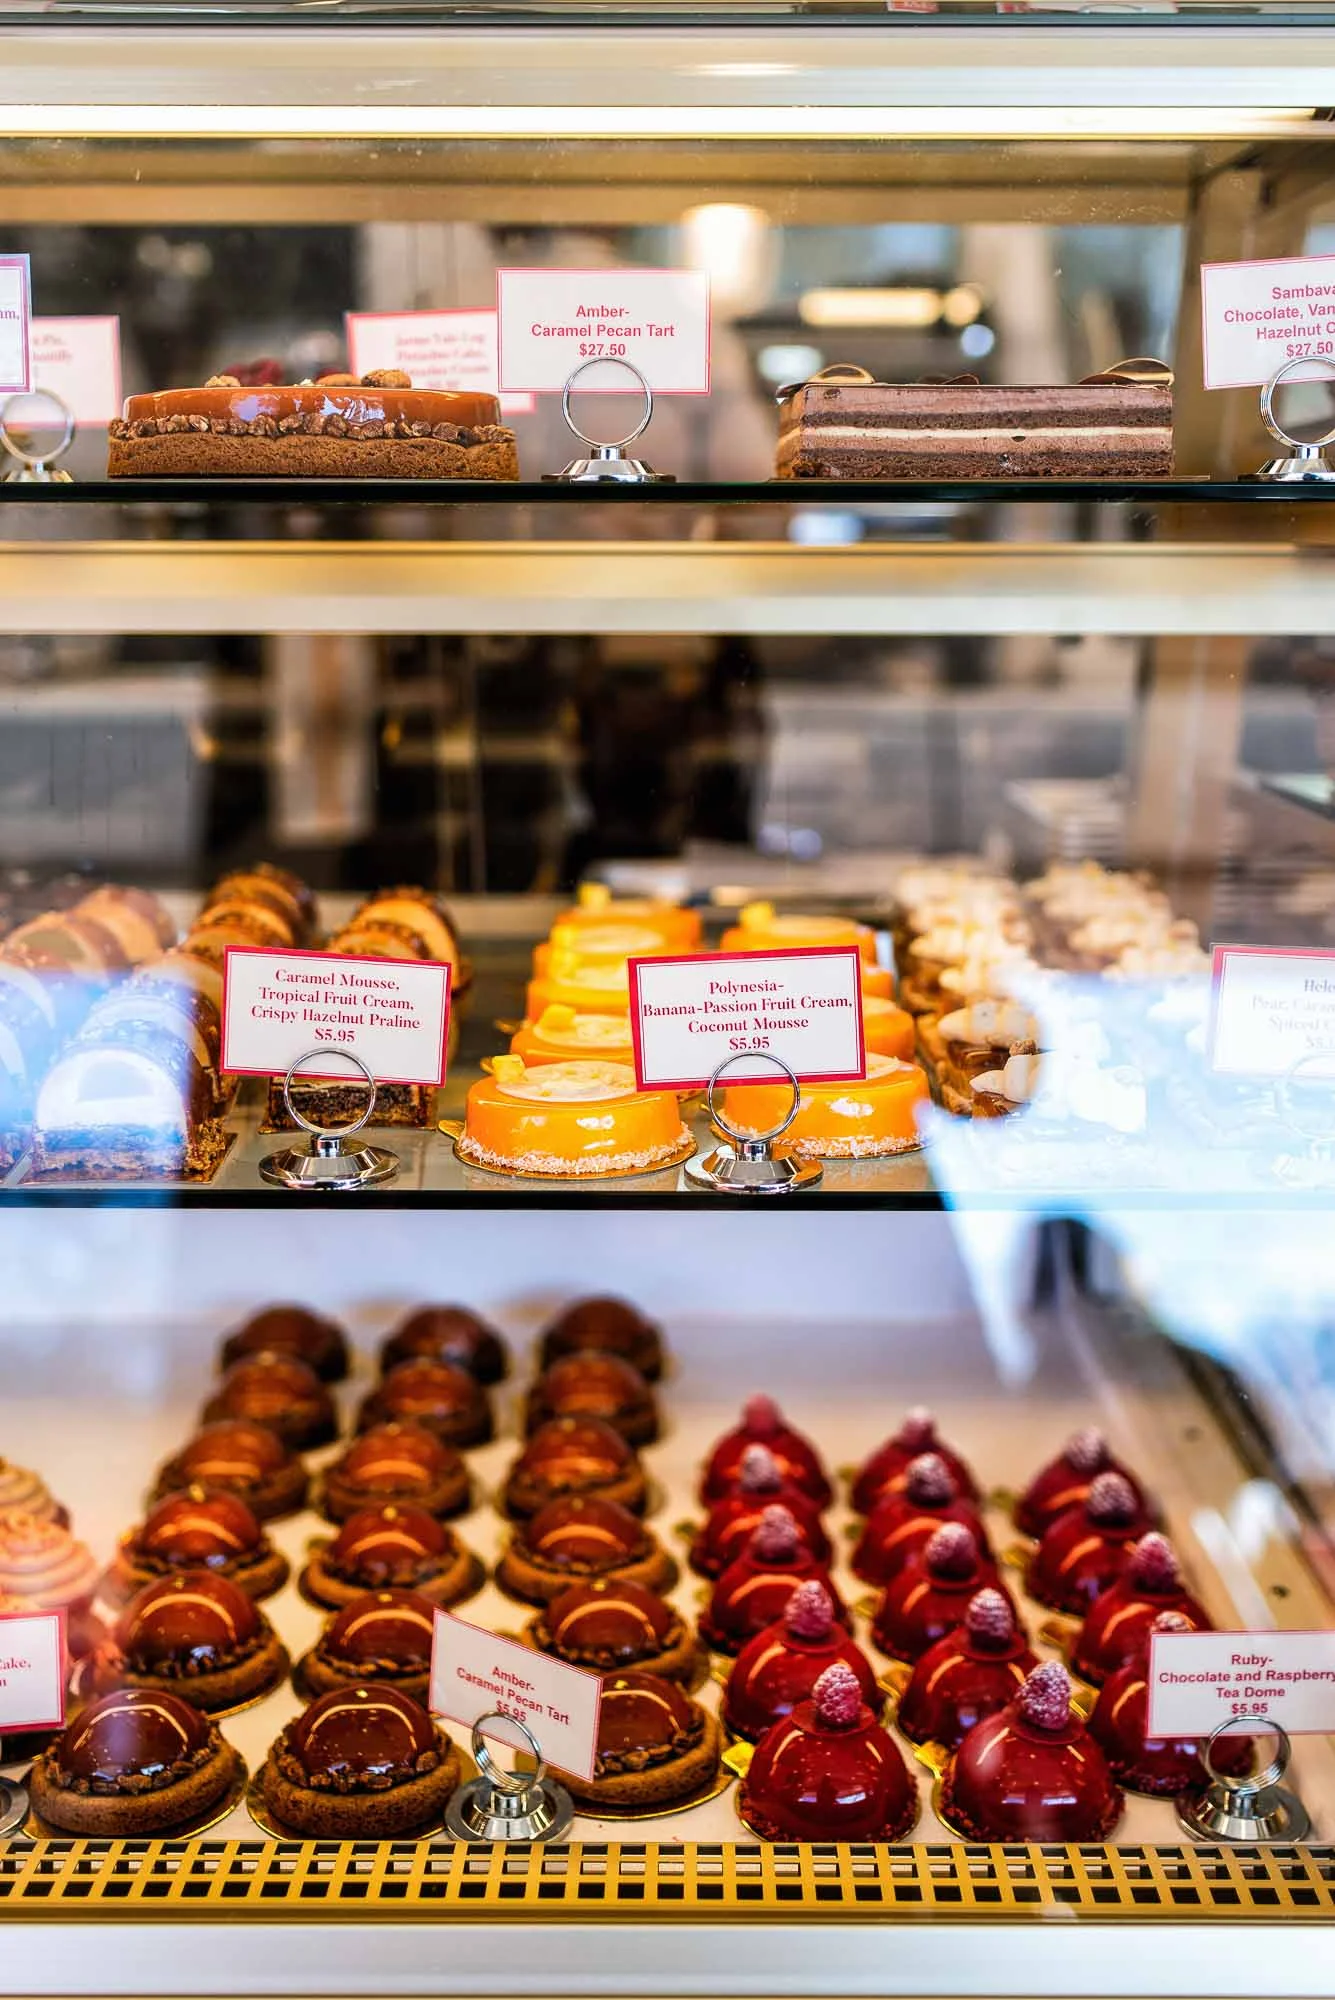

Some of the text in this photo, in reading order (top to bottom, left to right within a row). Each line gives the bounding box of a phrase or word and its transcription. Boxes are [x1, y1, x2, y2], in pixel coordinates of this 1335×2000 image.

[576, 305, 630, 318] Amber-
[1224, 306, 1304, 323] Chocolate,
[531, 324, 675, 337] Caramel Pecan Tart
[1257, 323, 1321, 340] Hazelnut
[579, 343, 626, 357] $27.50
[1286, 341, 1334, 358] $27.50
[275, 968, 400, 990] Caramel Mousse,
[709, 980, 785, 997] Polynesia-
[259, 986, 414, 1010] Tropical Fruit Cream,
[643, 995, 853, 1017] Banana-Passion Fruit Cream,
[251, 1004, 421, 1029] Crispy Hazelnut Praline
[688, 1017, 809, 1033] Coconut Mousse
[314, 1028, 355, 1042] $5.95
[729, 1036, 770, 1050] $5.95
[1231, 1654, 1273, 1667] Ruby-
[492, 1666, 535, 1691] Amber-
[1159, 1672, 1231, 1683] Chocolate
[1235, 1671, 1261, 1682] and
[456, 1667, 570, 1725] Caramel Pecan Tart
[1216, 1686, 1285, 1698] Tea Dome
[496, 1700, 527, 1722] $595
[1231, 1703, 1268, 1714] $5.95
